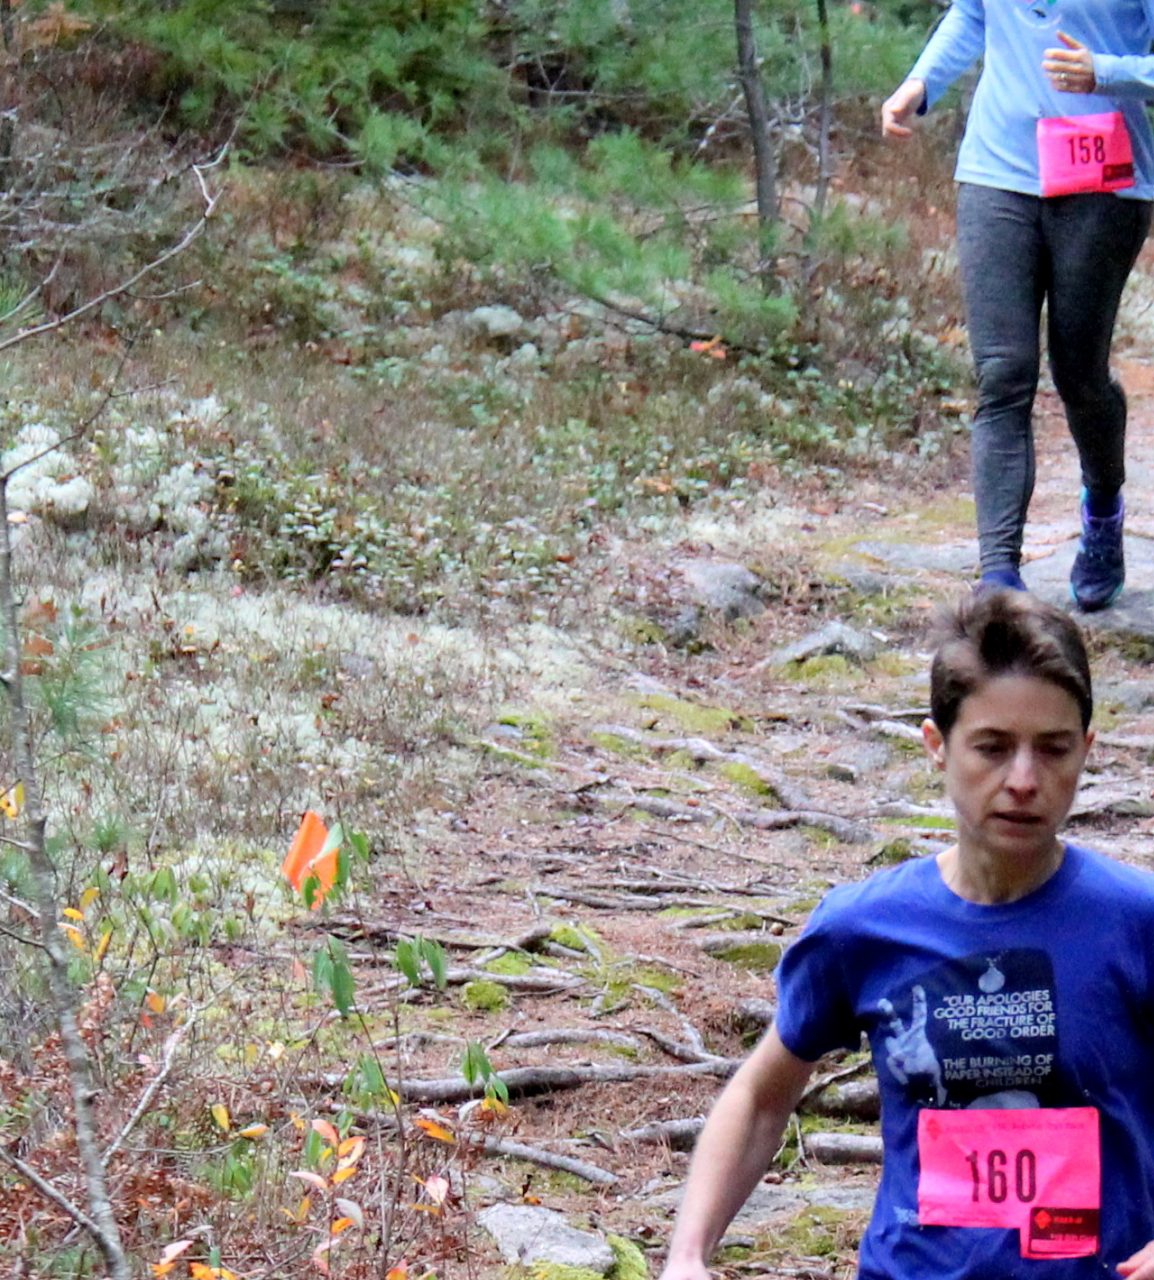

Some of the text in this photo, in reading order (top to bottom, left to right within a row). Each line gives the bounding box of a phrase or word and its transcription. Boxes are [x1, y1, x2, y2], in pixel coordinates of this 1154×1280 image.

[1068, 135, 1106, 165] 158
[976, 990, 1050, 1006] APOLOGIES
[933, 1001, 1053, 1019] GOOD FRIENDS FOR
[948, 1013, 1056, 1030] THE FRACTURE OF
[961, 1025, 1056, 1040] GOOD ORDER
[943, 1054, 1054, 1070] THE BURNING OF
[944, 1065, 1052, 1080] PAPER INSTEAD OF
[975, 1077, 1043, 1088] CHILDREN
[965, 1149, 1037, 1203] 160
